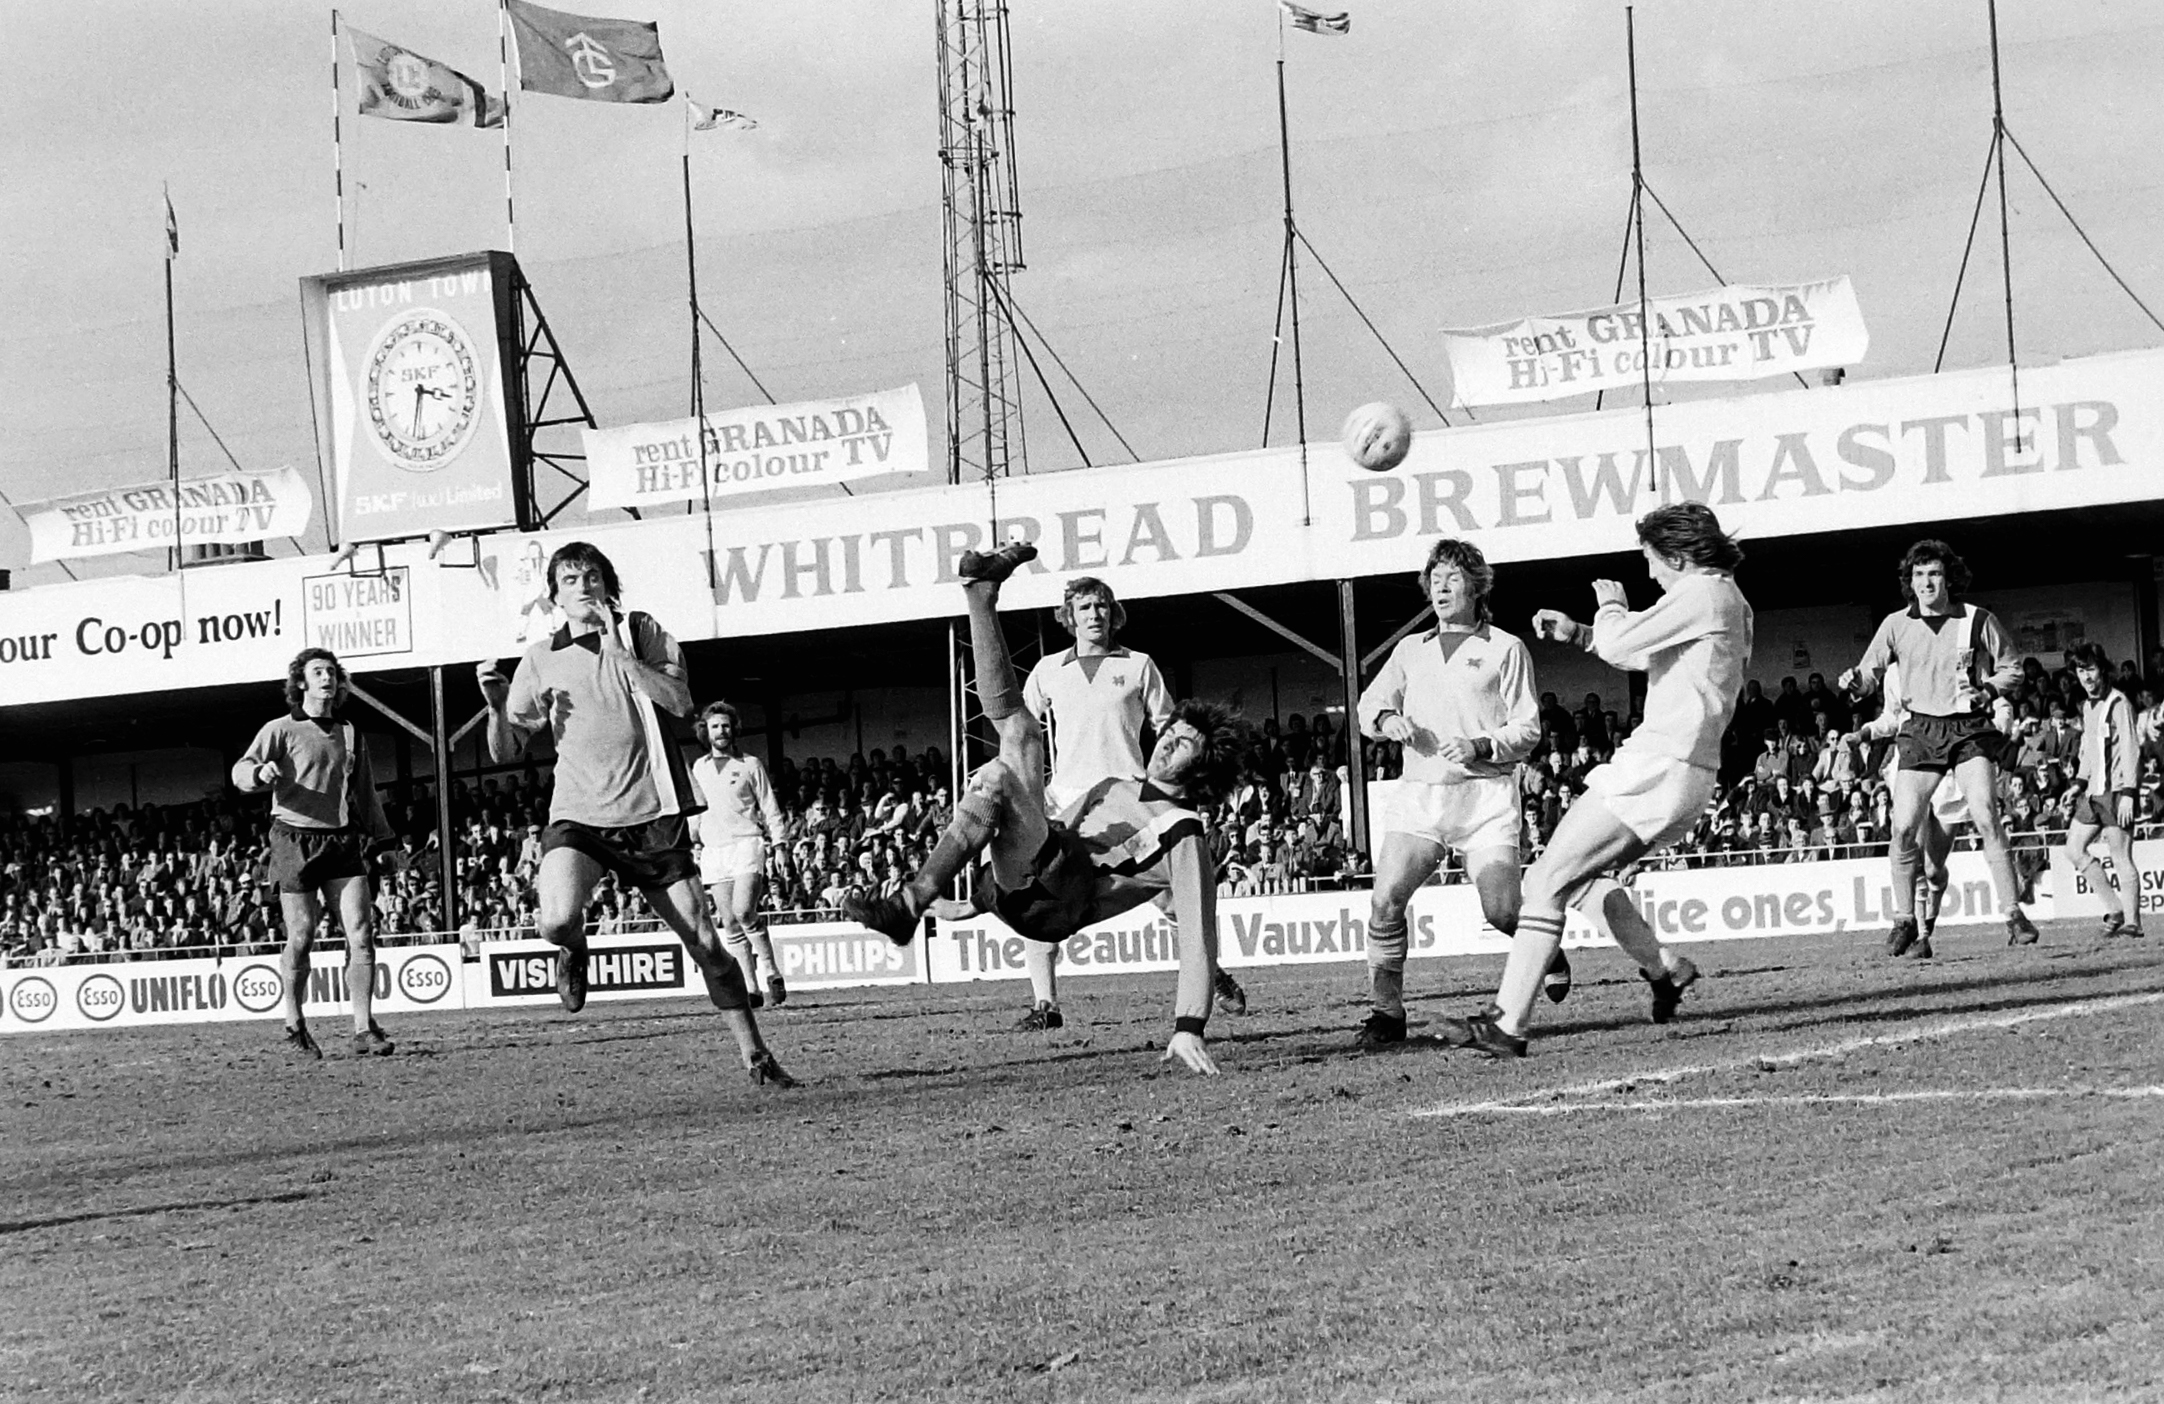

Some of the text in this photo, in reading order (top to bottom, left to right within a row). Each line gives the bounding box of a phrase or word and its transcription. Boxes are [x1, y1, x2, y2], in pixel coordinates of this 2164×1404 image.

[337, 281, 412, 311] LUTON
[1503, 294, 1814, 357] rent GRANADA
[402, 366, 441, 382] SKF
[1509, 324, 1815, 389] Hi-Fi colour TV
[632, 433, 692, 465] rent
[715, 448, 830, 484] colour
[841, 432, 893, 467] TV
[62, 496, 122, 521] rent
[356, 491, 408, 515] SKF
[699, 400, 2128, 607] WHITBREAD BREWMASTER
[72, 504, 277, 546] Hi-Fi coour TV
[313, 575, 401, 611] 90 YEARS
[76, 616, 183, 660] Co-op
[197, 598, 282, 644] now!
[318, 618, 397, 650] WINNER
[1721, 889, 1848, 932] ones,
[782, 938, 904, 977] PHILIPS
[951, 905, 1435, 973] The eauti Vauxhls
[17, 962, 444, 1014] Esso Esso UNIFLO Esso NIO Esso
[497, 951, 675, 990] VISINHIRE
